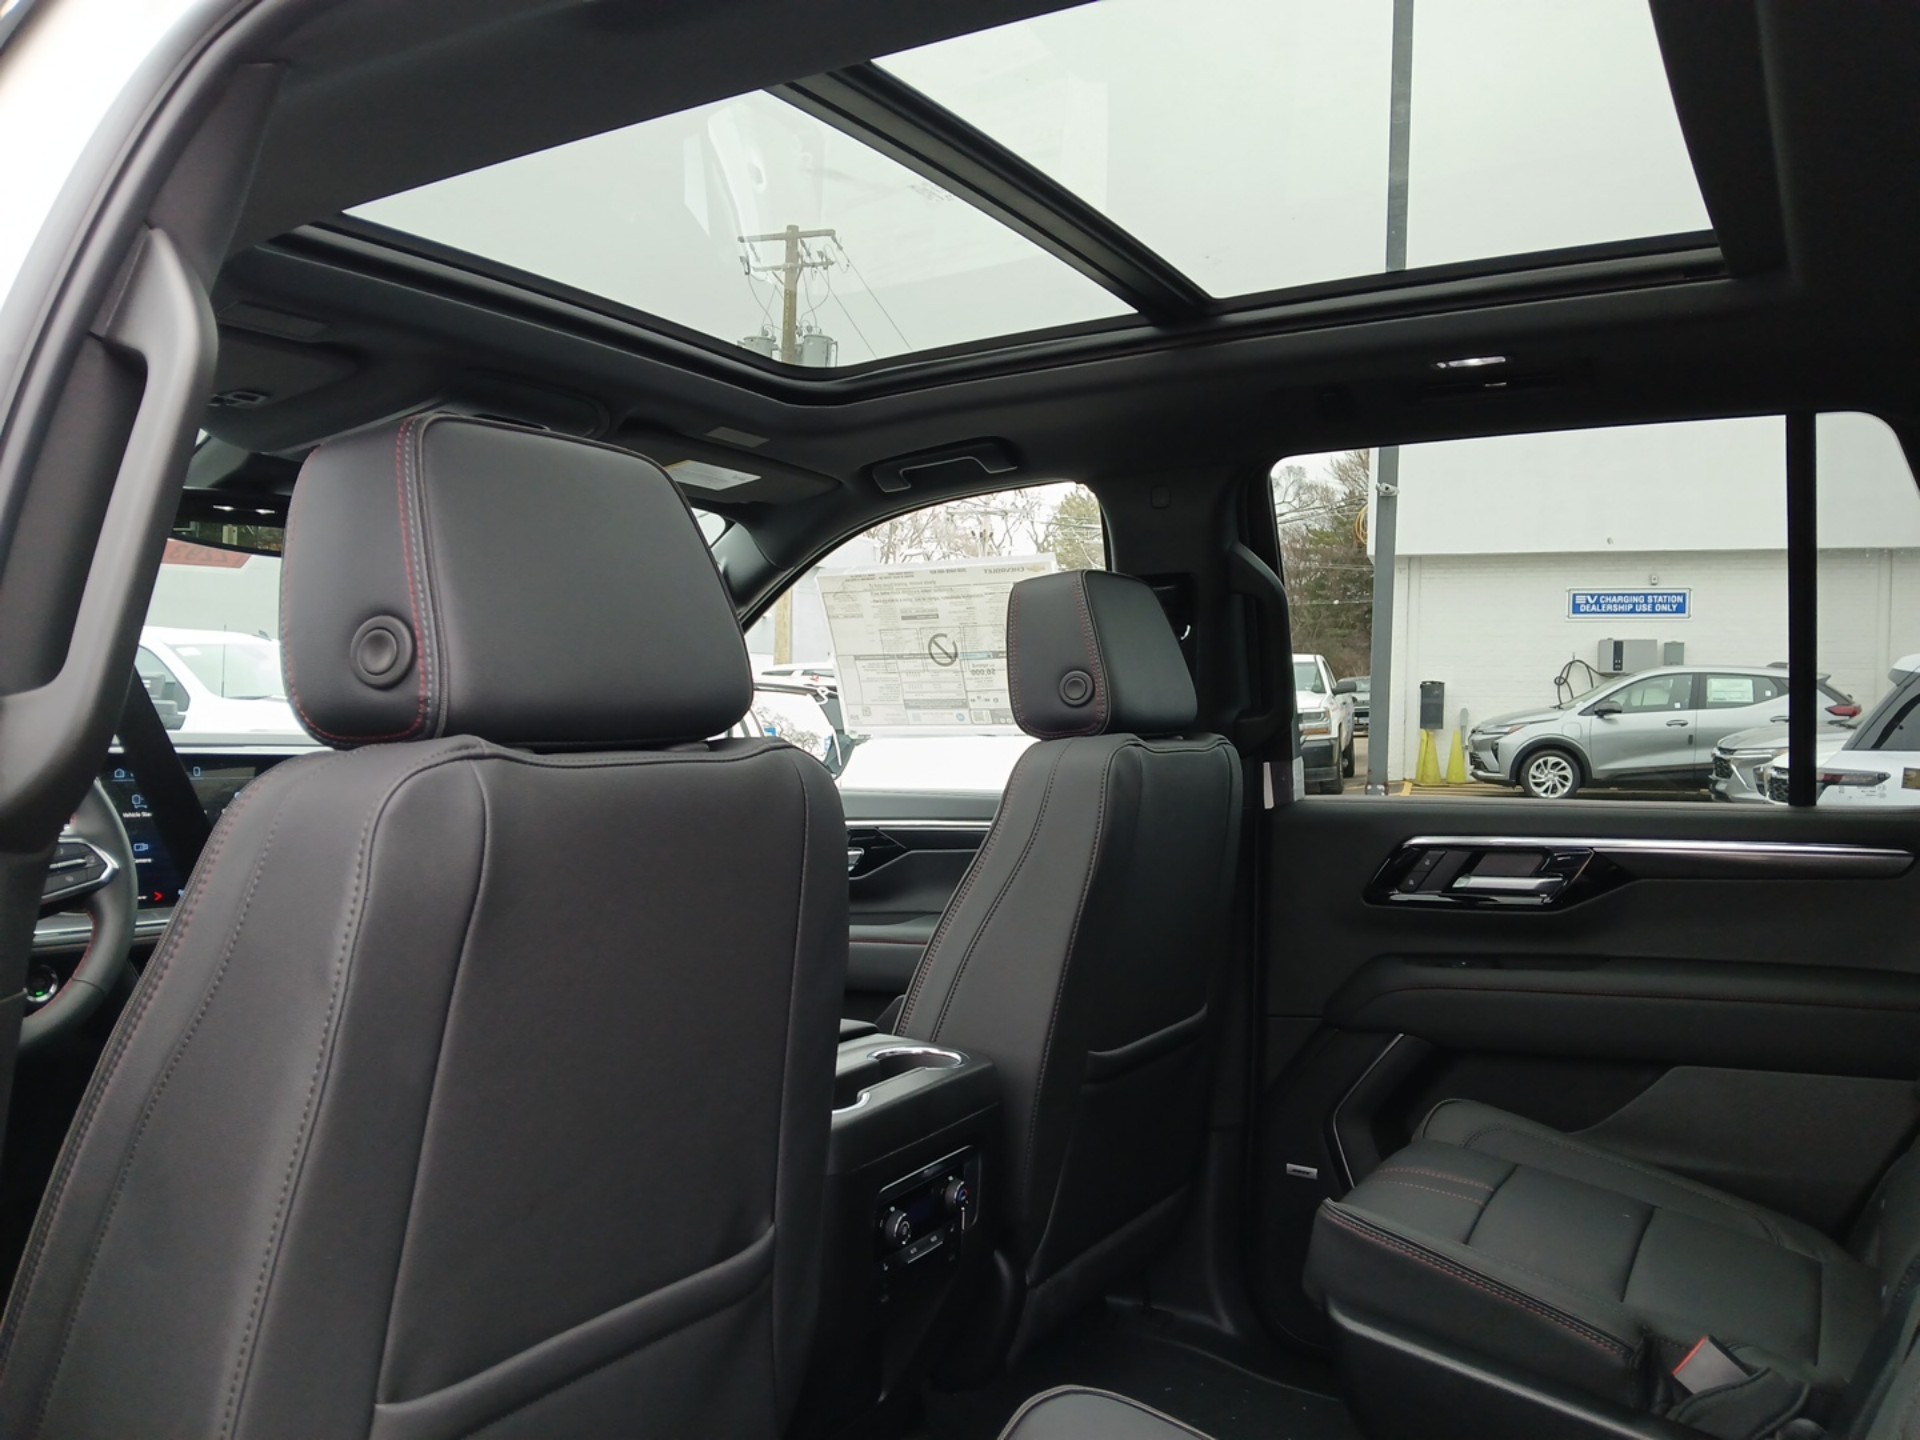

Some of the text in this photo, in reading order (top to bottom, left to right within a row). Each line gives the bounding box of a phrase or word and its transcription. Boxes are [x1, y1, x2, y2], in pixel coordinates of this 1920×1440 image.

[1575, 595, 1684, 604] EV CHARGING STATION
[1580, 603, 1678, 612] DEALERSHIP USE ONLY
